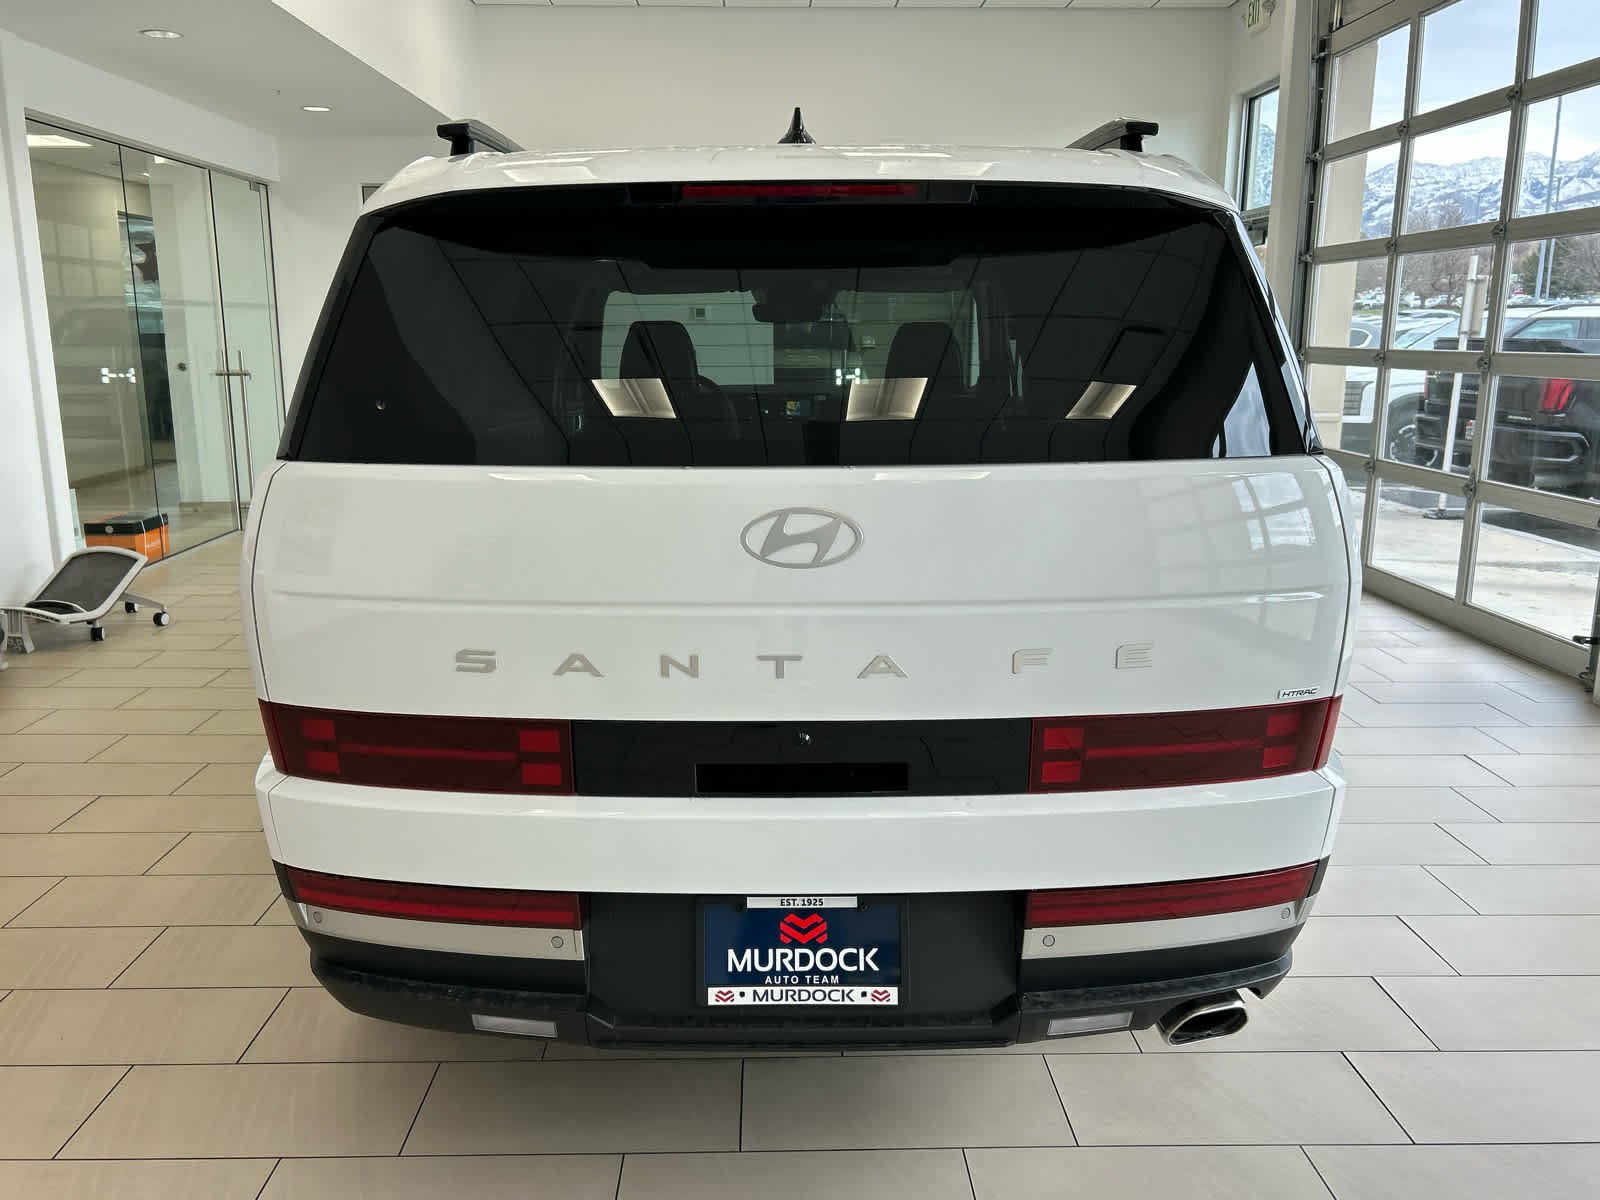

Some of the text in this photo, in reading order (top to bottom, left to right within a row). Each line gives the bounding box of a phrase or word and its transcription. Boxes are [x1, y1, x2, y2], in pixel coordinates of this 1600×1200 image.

[455, 642, 1153, 679] SANTA FE
[1281, 688, 1318, 697] HTRAC
[780, 898, 824, 907] EST. 1925
[727, 947, 879, 972] MURDOCK
[765, 975, 839, 984] AUTO TEAM
[752, 989, 855, 1002] MURDOCK
